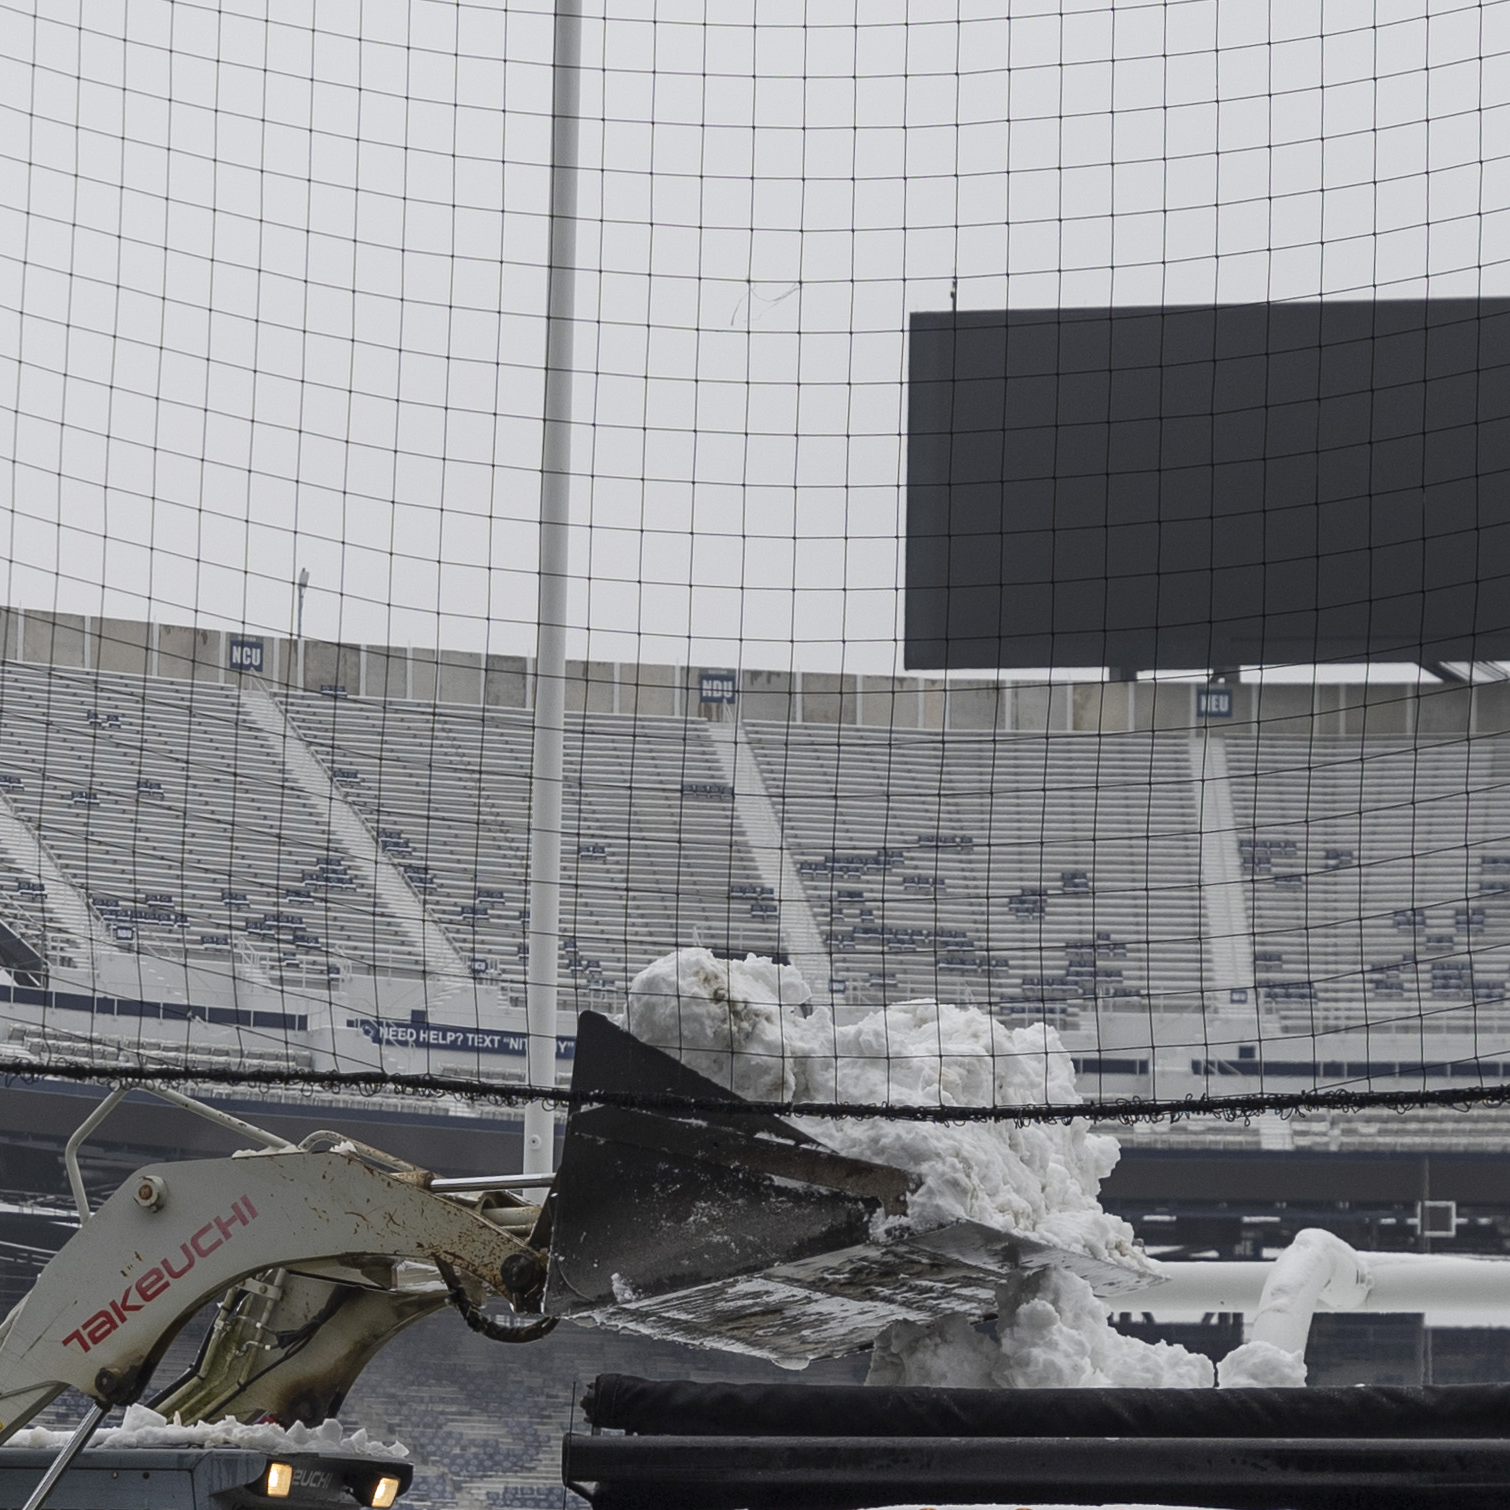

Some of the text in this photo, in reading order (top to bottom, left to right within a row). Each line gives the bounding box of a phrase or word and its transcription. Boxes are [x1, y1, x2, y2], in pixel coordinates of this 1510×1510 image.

[232, 646, 261, 665] NCU
[702, 679, 733, 698] NDU
[379, 1025, 417, 1041] NEED
[419, 1030, 463, 1045] HELP?
[466, 1033, 500, 1048] TEXT
